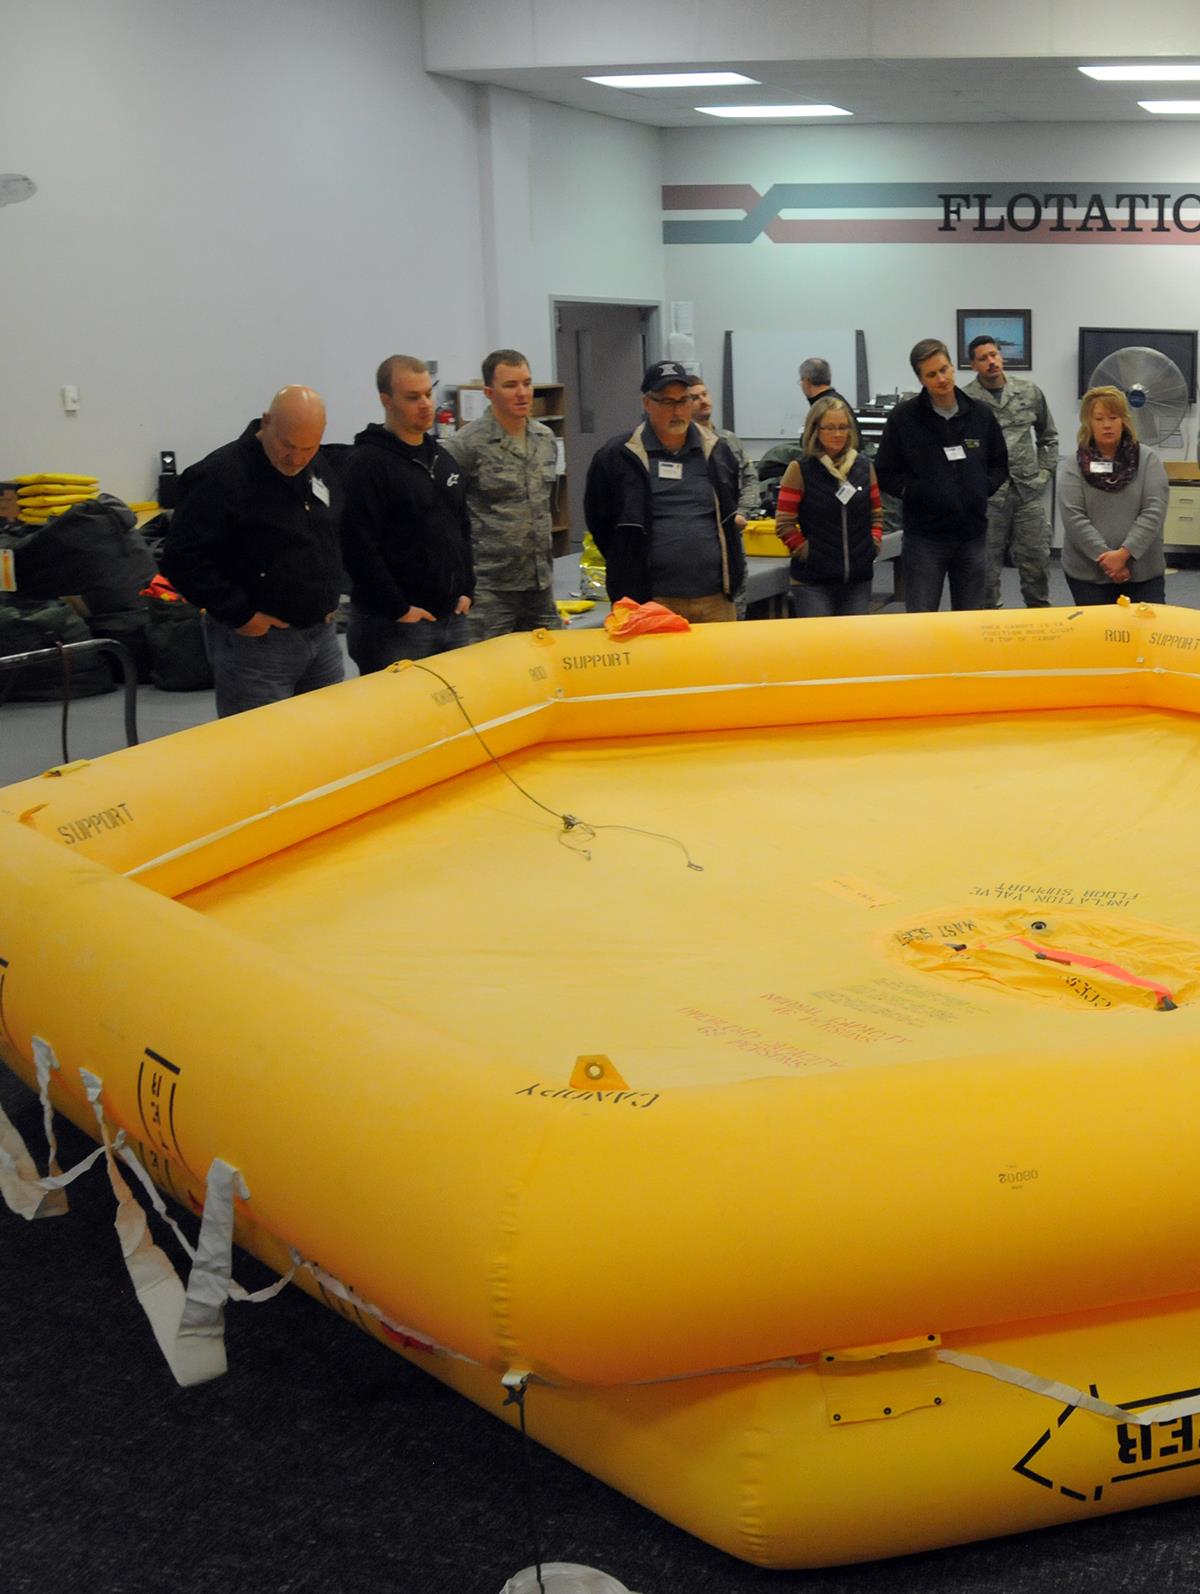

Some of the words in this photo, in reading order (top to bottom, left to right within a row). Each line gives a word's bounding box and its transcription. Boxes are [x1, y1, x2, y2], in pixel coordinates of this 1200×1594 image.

[1104, 629, 1130, 645] ROD
[562, 651, 632, 671] SUPPORT
[56, 802, 134, 845] SUPPORT
[968, 885, 1025, 903] VALVE
[995, 882, 1074, 896] SUPPORT
[1082, 889, 1140, 900] FLOOR
[1036, 895, 1132, 908] INFLATION
[515, 1083, 660, 1109] CANOPY
